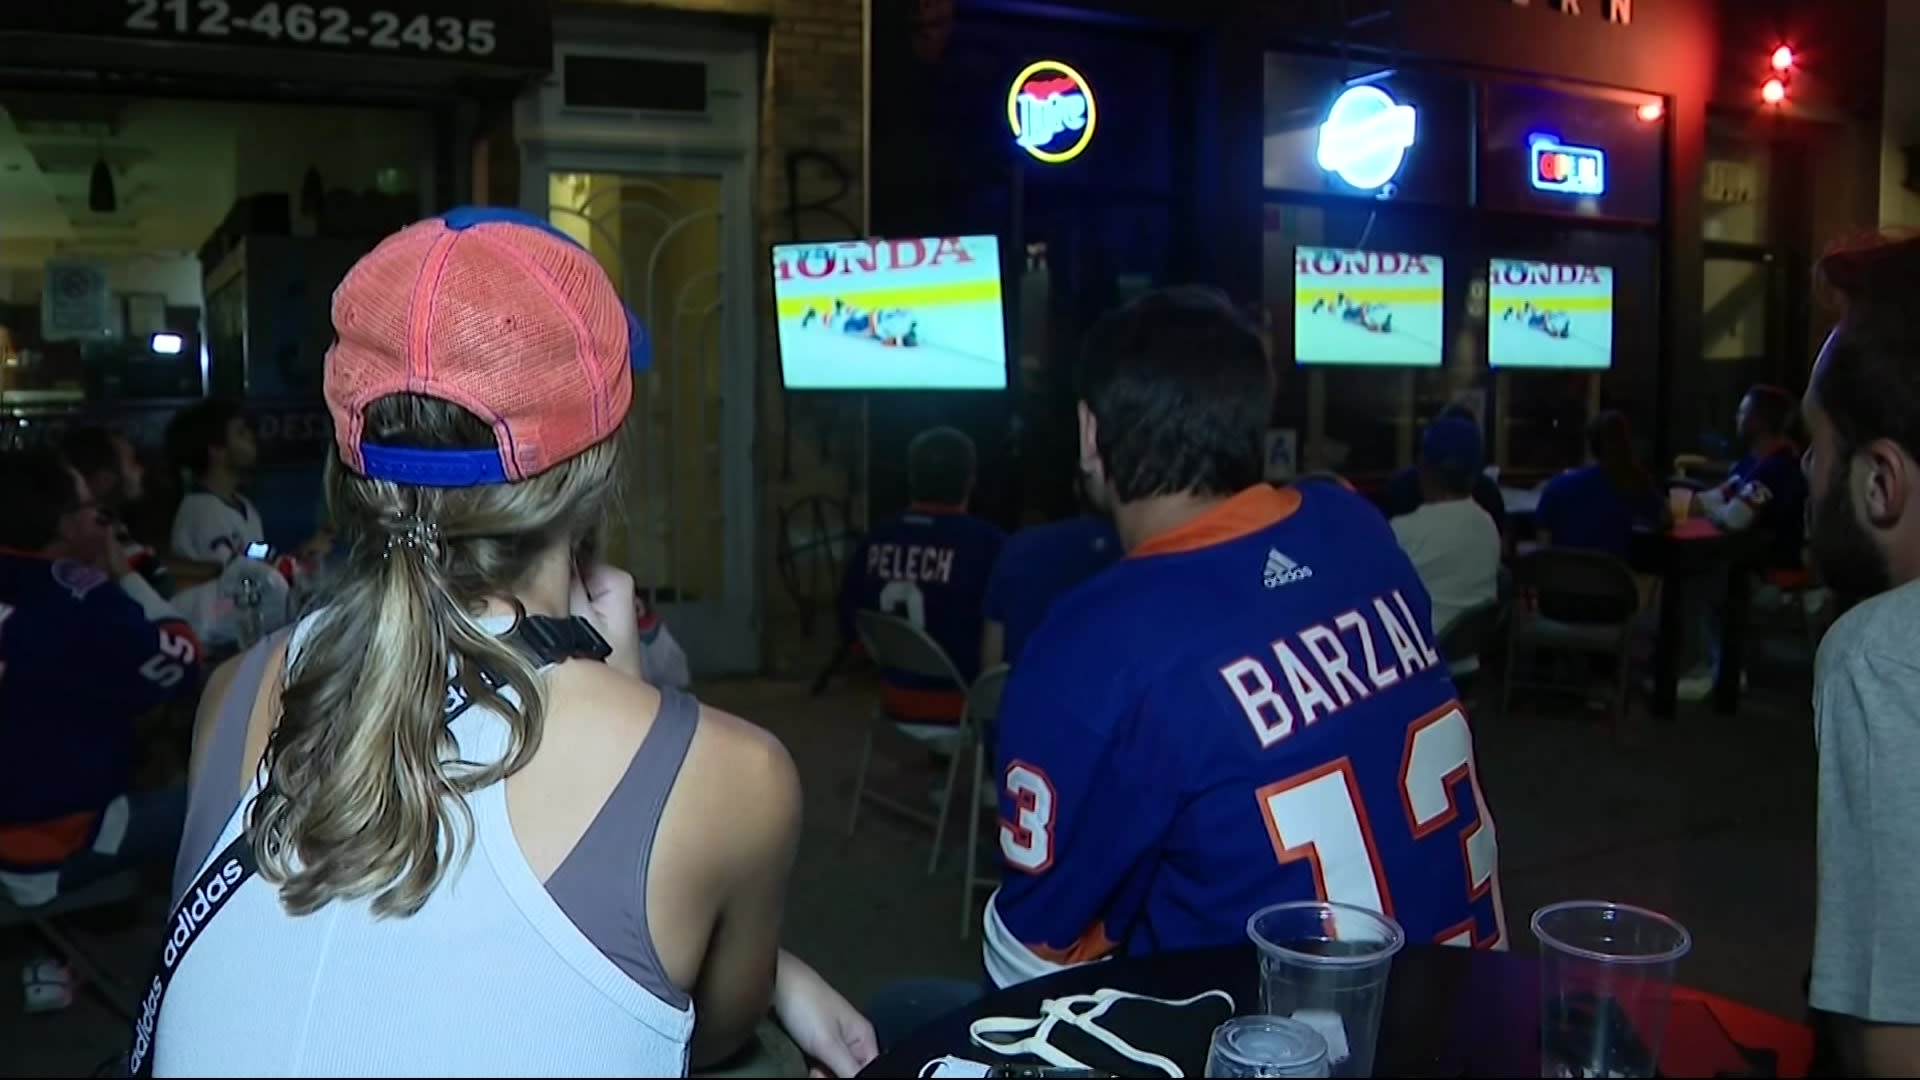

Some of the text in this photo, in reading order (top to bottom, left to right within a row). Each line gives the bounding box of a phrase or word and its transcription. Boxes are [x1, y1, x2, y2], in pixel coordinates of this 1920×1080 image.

[125, 0, 497, 54] 212-462-2435
[866, 543, 955, 584] PELECH
[139, 628, 196, 688] 55
[1219, 588, 1440, 749] BARZAL
[998, 758, 1057, 875] 3
[1255, 698, 1510, 951] 13
[130, 857, 244, 1074] adidas adidas
